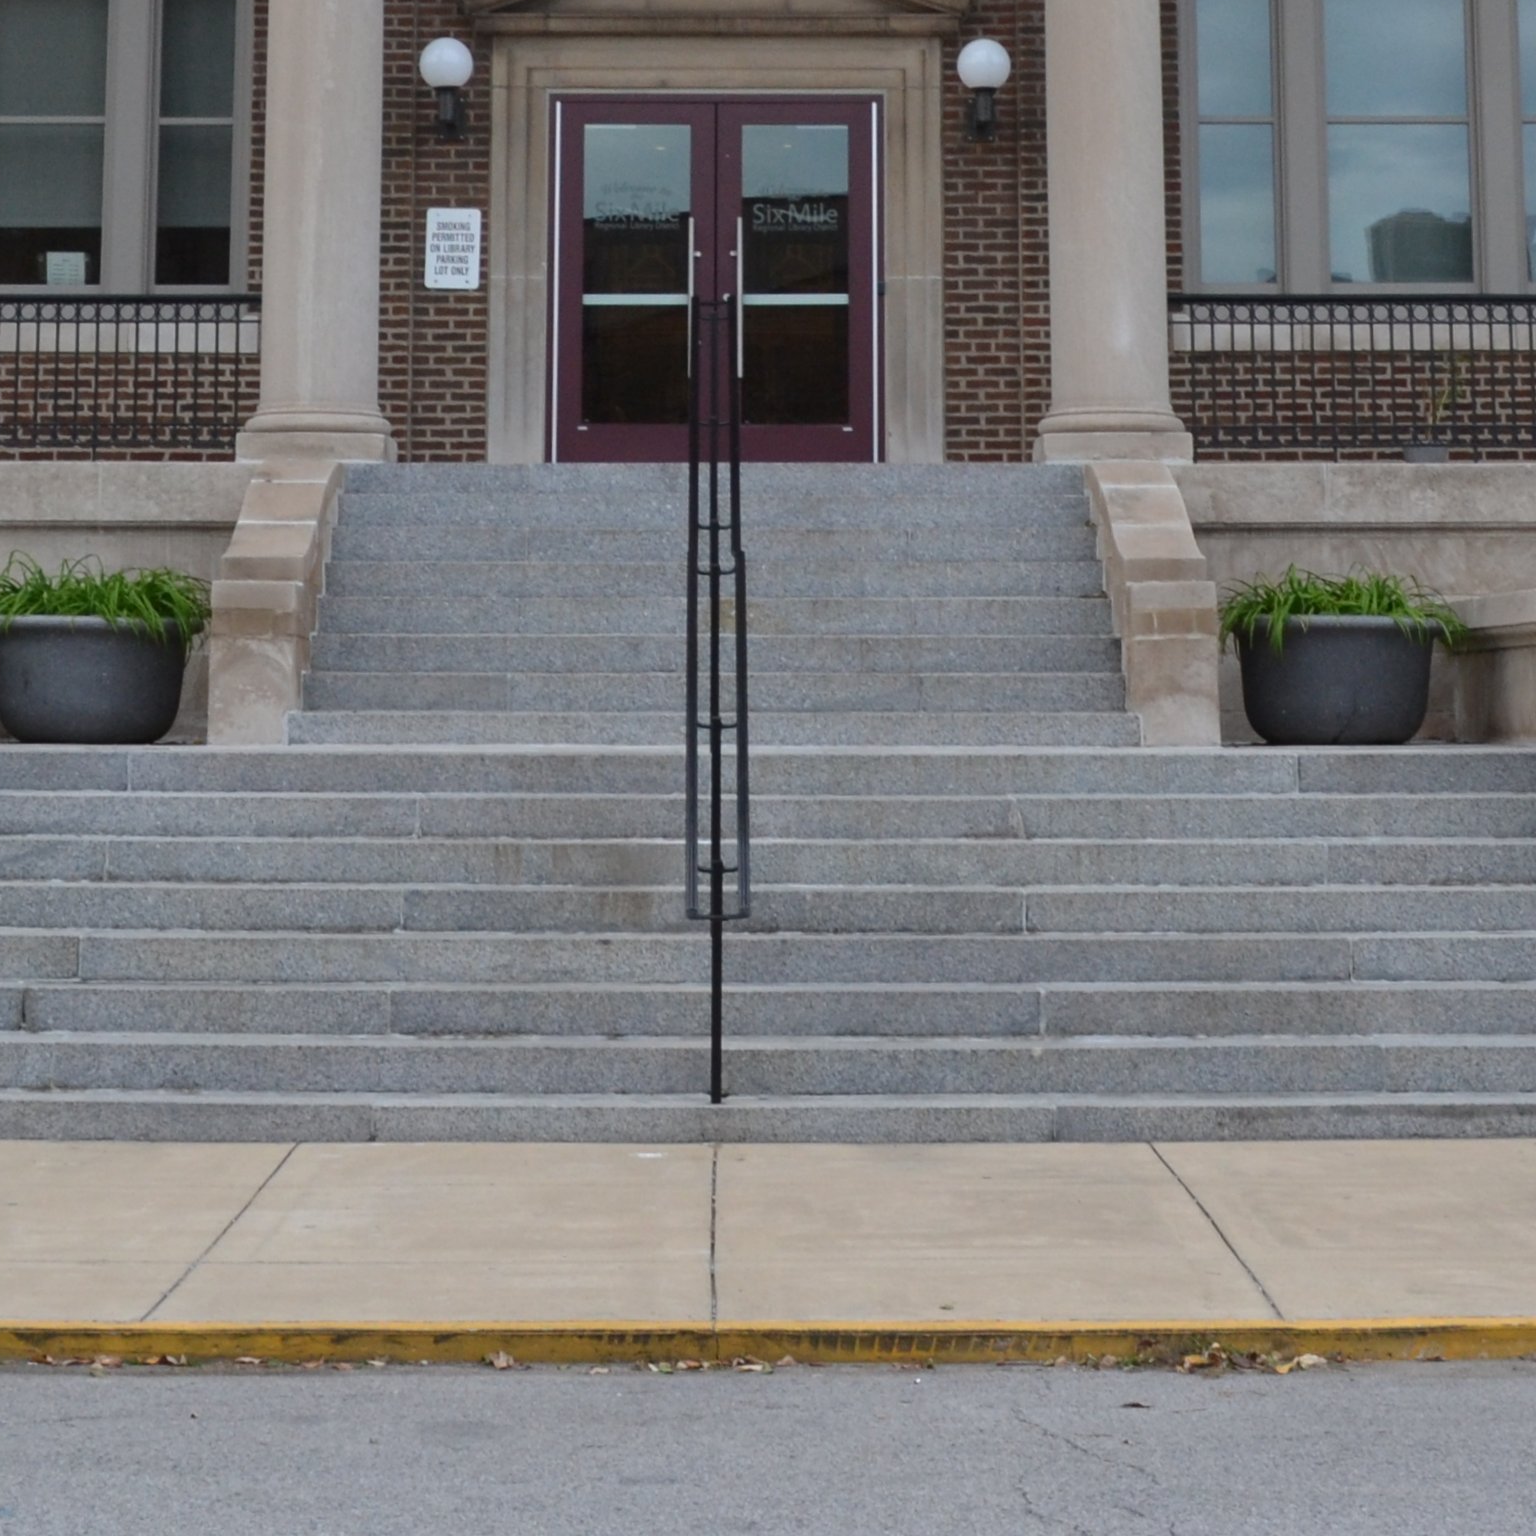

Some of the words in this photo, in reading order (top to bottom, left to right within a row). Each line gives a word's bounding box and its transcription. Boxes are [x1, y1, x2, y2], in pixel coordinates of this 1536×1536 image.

[436, 222, 471, 231] SMOKING
[432, 233, 475, 242] PERMITTED
[430, 244, 440, 253] ON
[443, 244, 475, 253] LIBRARY
[436, 255, 469, 264] PARKING
[434, 266, 448, 275] LOT
[451, 267, 469, 276] ONLY
